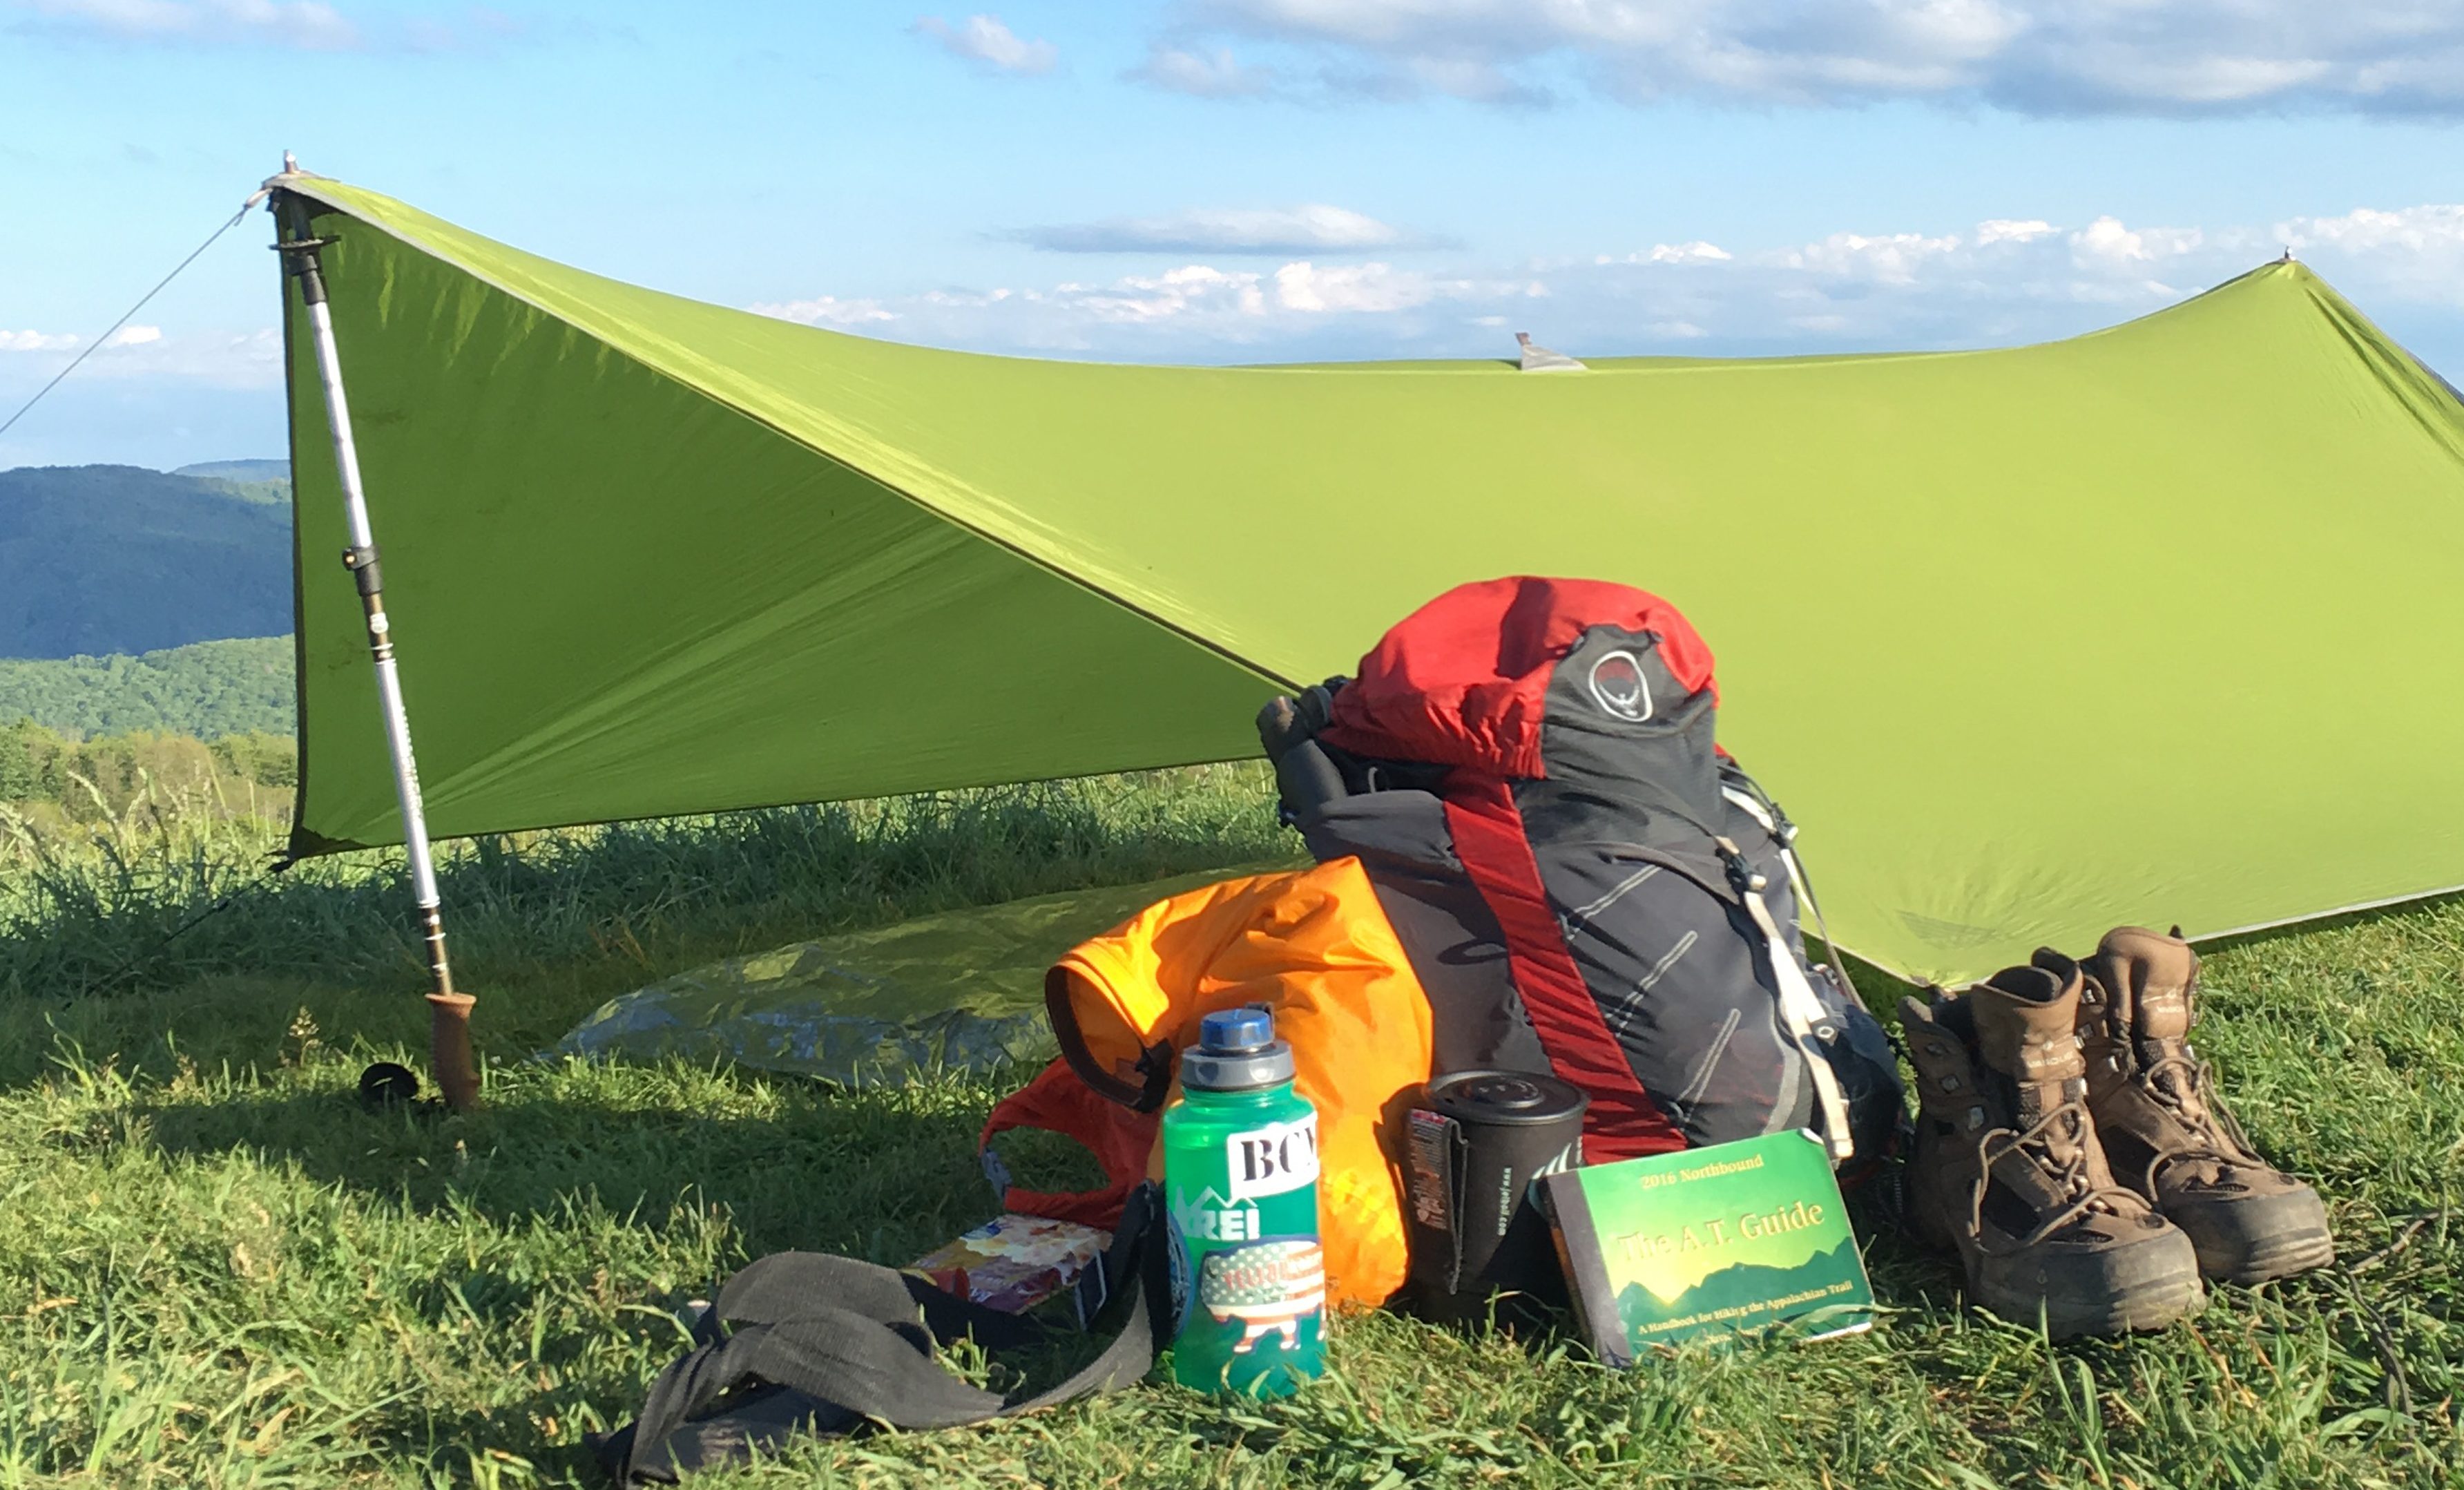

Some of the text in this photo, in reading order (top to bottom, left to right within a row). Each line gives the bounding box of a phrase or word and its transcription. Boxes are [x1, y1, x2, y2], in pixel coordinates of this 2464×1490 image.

[1641, 1153, 1764, 1190] 2016 Northbound
[1195, 1208, 1260, 1241] REI
[1616, 1200, 1825, 1260] The A.T. Guide
[1638, 1324, 1648, 1335] A
[1648, 1315, 1697, 1333] Handbook
[1697, 1312, 1713, 1323] for
[1749, 1301, 1765, 1312] the
[1766, 1289, 1827, 1310] Appalachian
[1827, 1279, 1854, 1295] Trail
